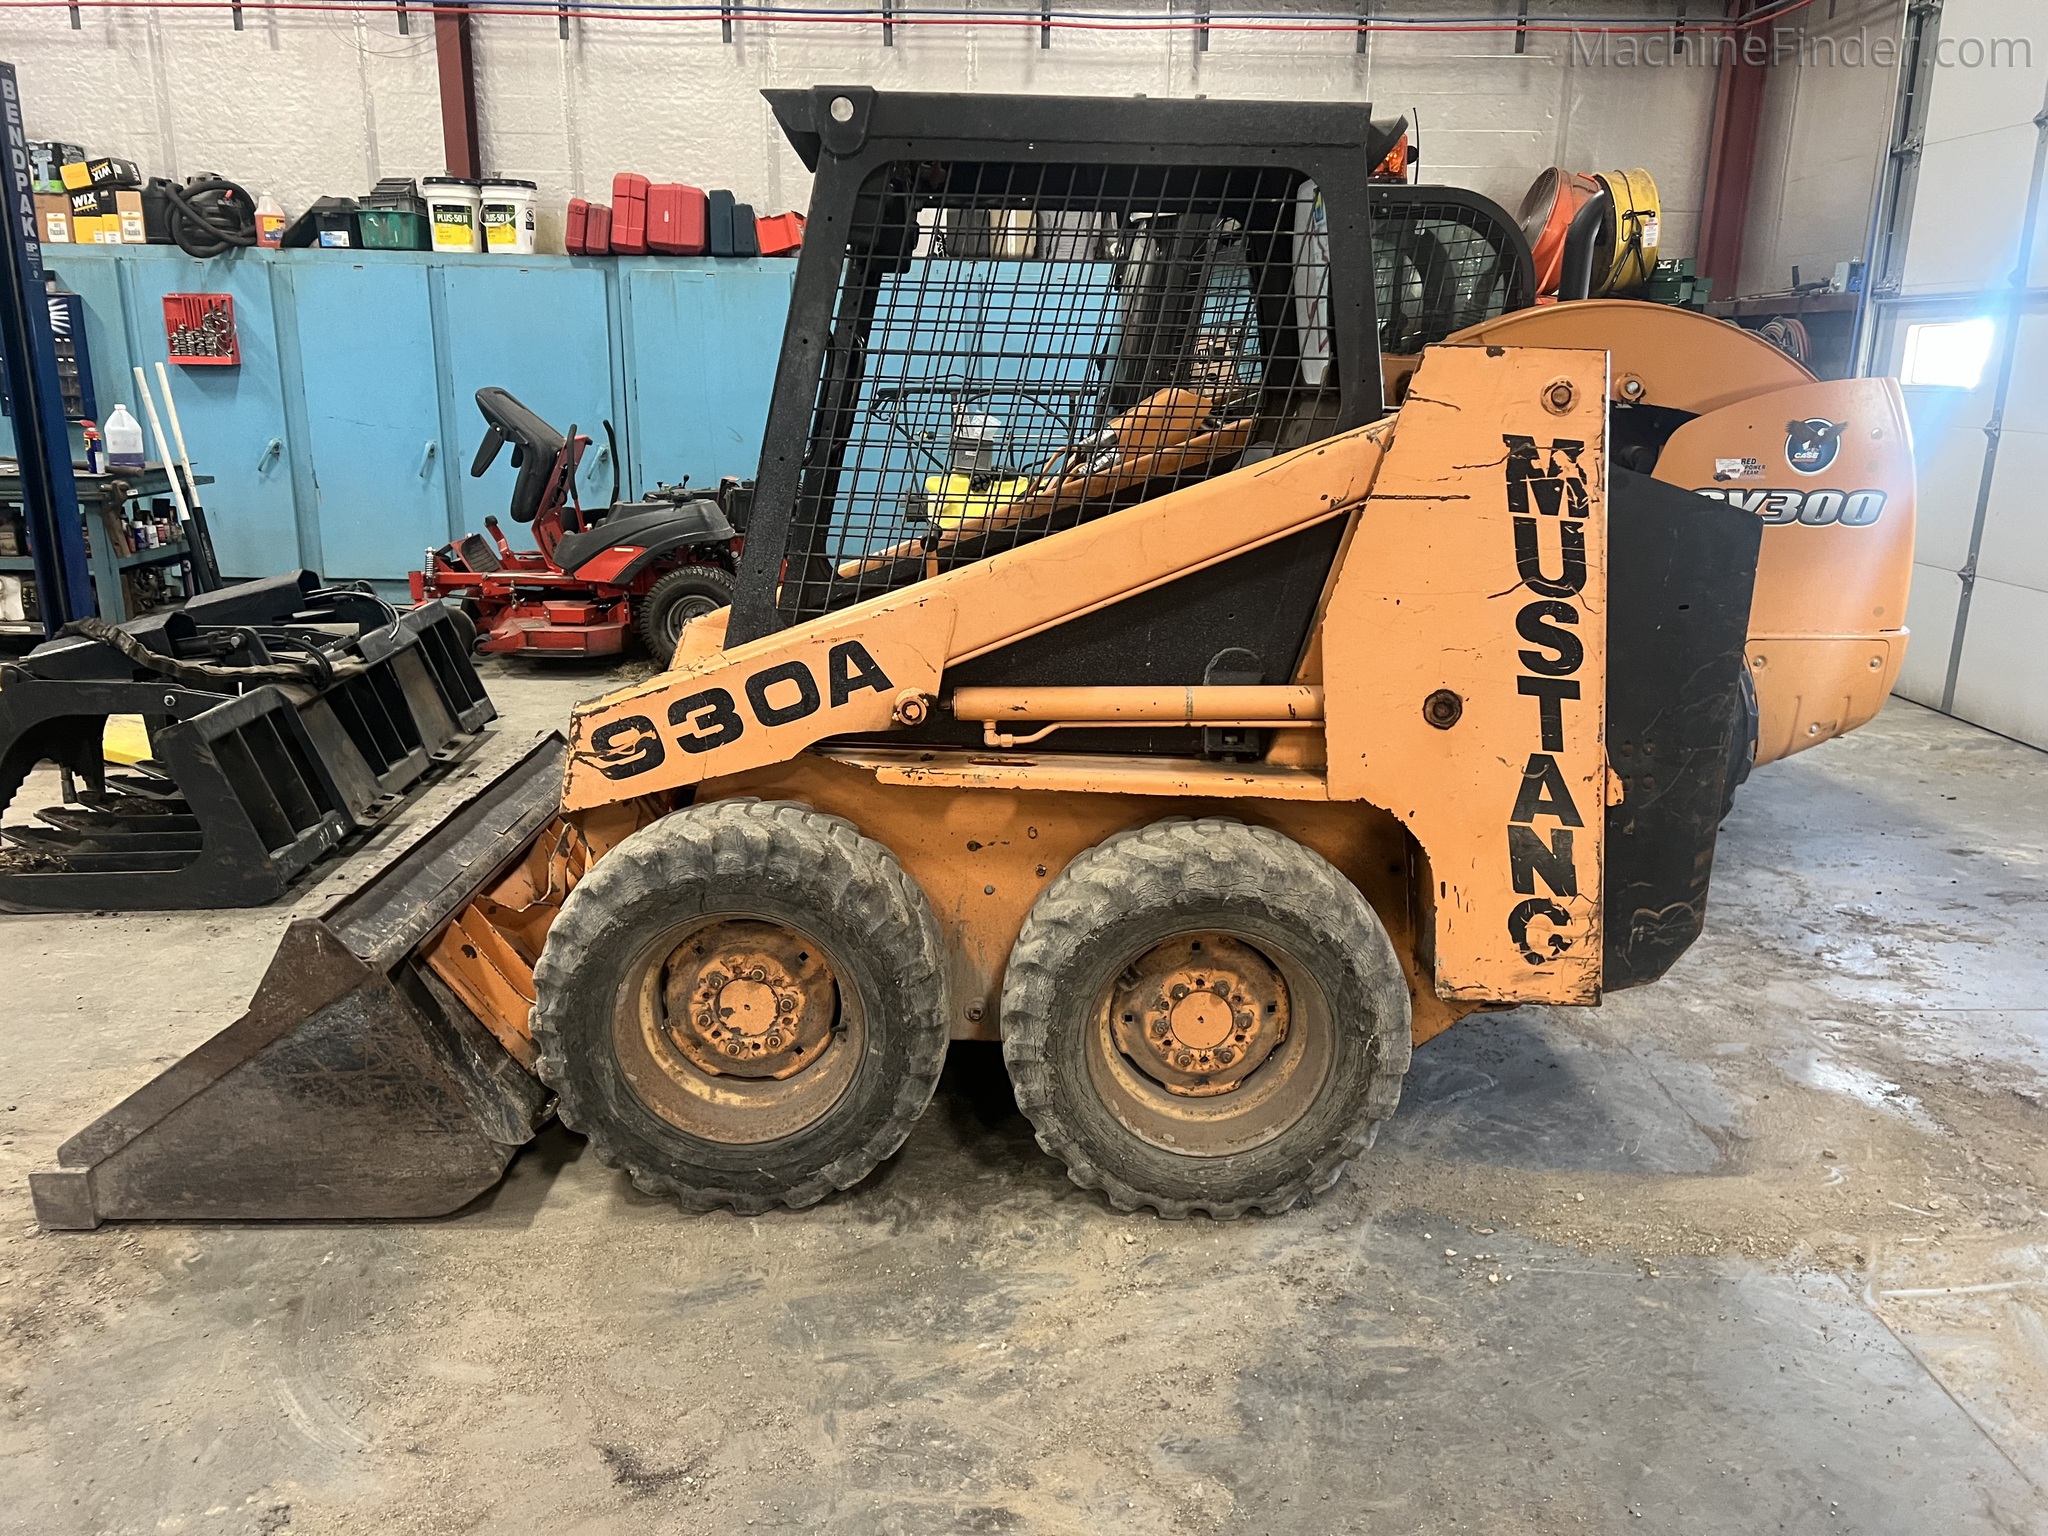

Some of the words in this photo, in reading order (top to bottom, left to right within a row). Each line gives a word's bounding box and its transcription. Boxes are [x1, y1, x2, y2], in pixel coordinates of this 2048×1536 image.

[1, 77, 36, 238] BENDPAK
[91, 165, 112, 182] WIX
[71, 192, 97, 208] WIX
[437, 214, 462, 223] PLUS-50
[591, 640, 895, 780] 930A
[1502, 434, 1590, 966] MUSTANG
